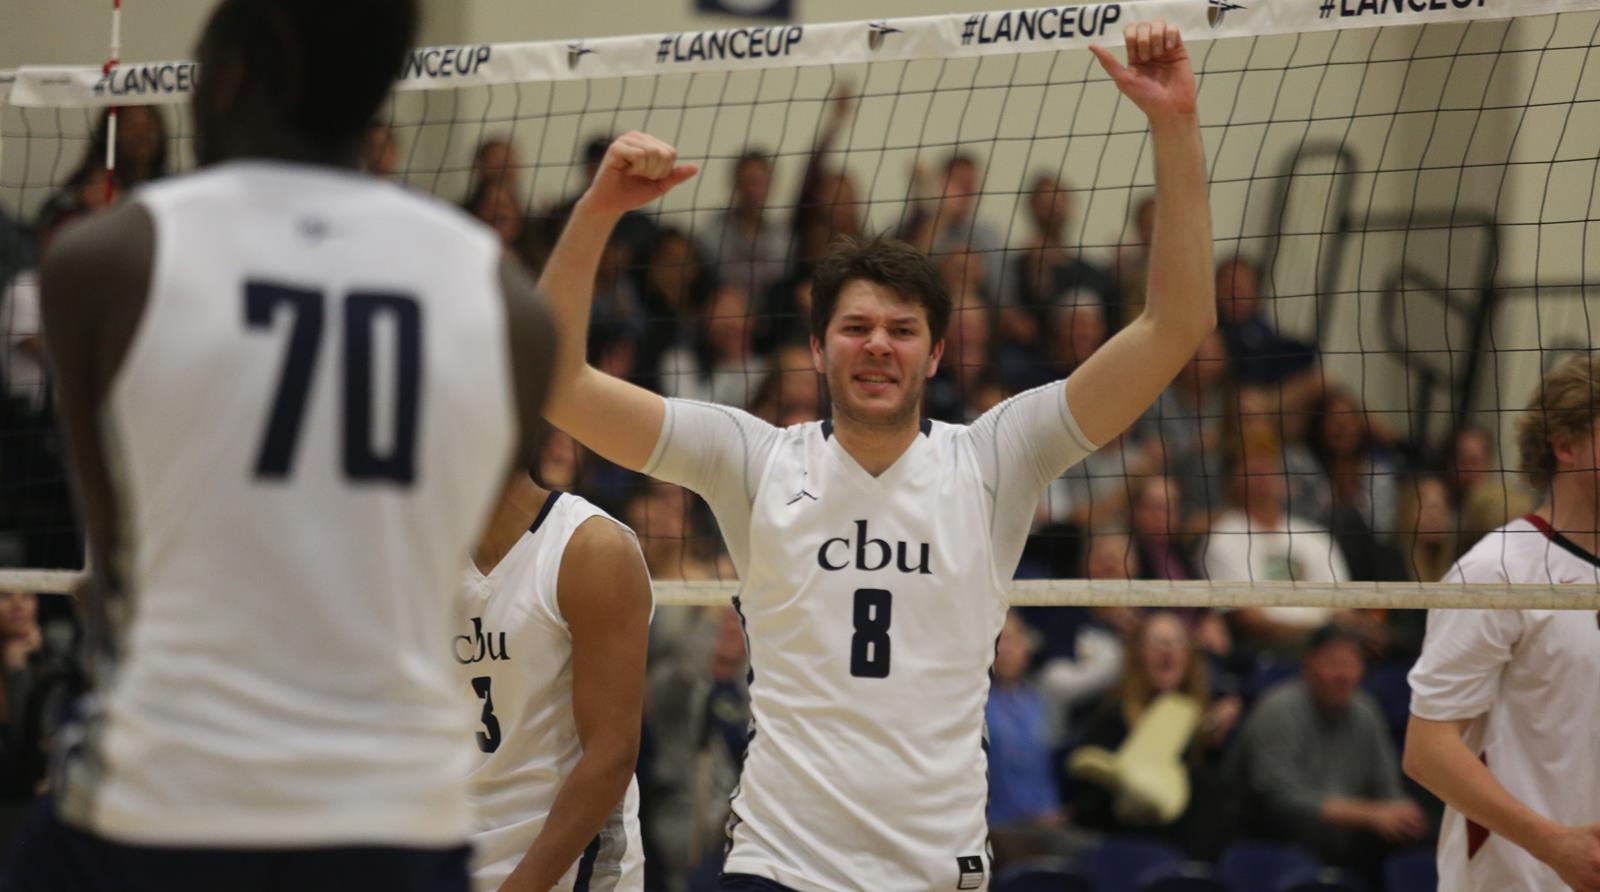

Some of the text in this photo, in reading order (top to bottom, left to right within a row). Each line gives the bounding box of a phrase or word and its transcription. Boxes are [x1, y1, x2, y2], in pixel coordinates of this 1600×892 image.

[656, 26, 803, 63] #LANCEUP
[961, 4, 1121, 46] #LANCEUP
[402, 46, 491, 80] NCEUP
[241, 277, 422, 487] 70
[817, 519, 933, 575] cbu
[850, 588, 892, 679] 8
[471, 676, 501, 754] 3
[967, 859, 977, 870] L
